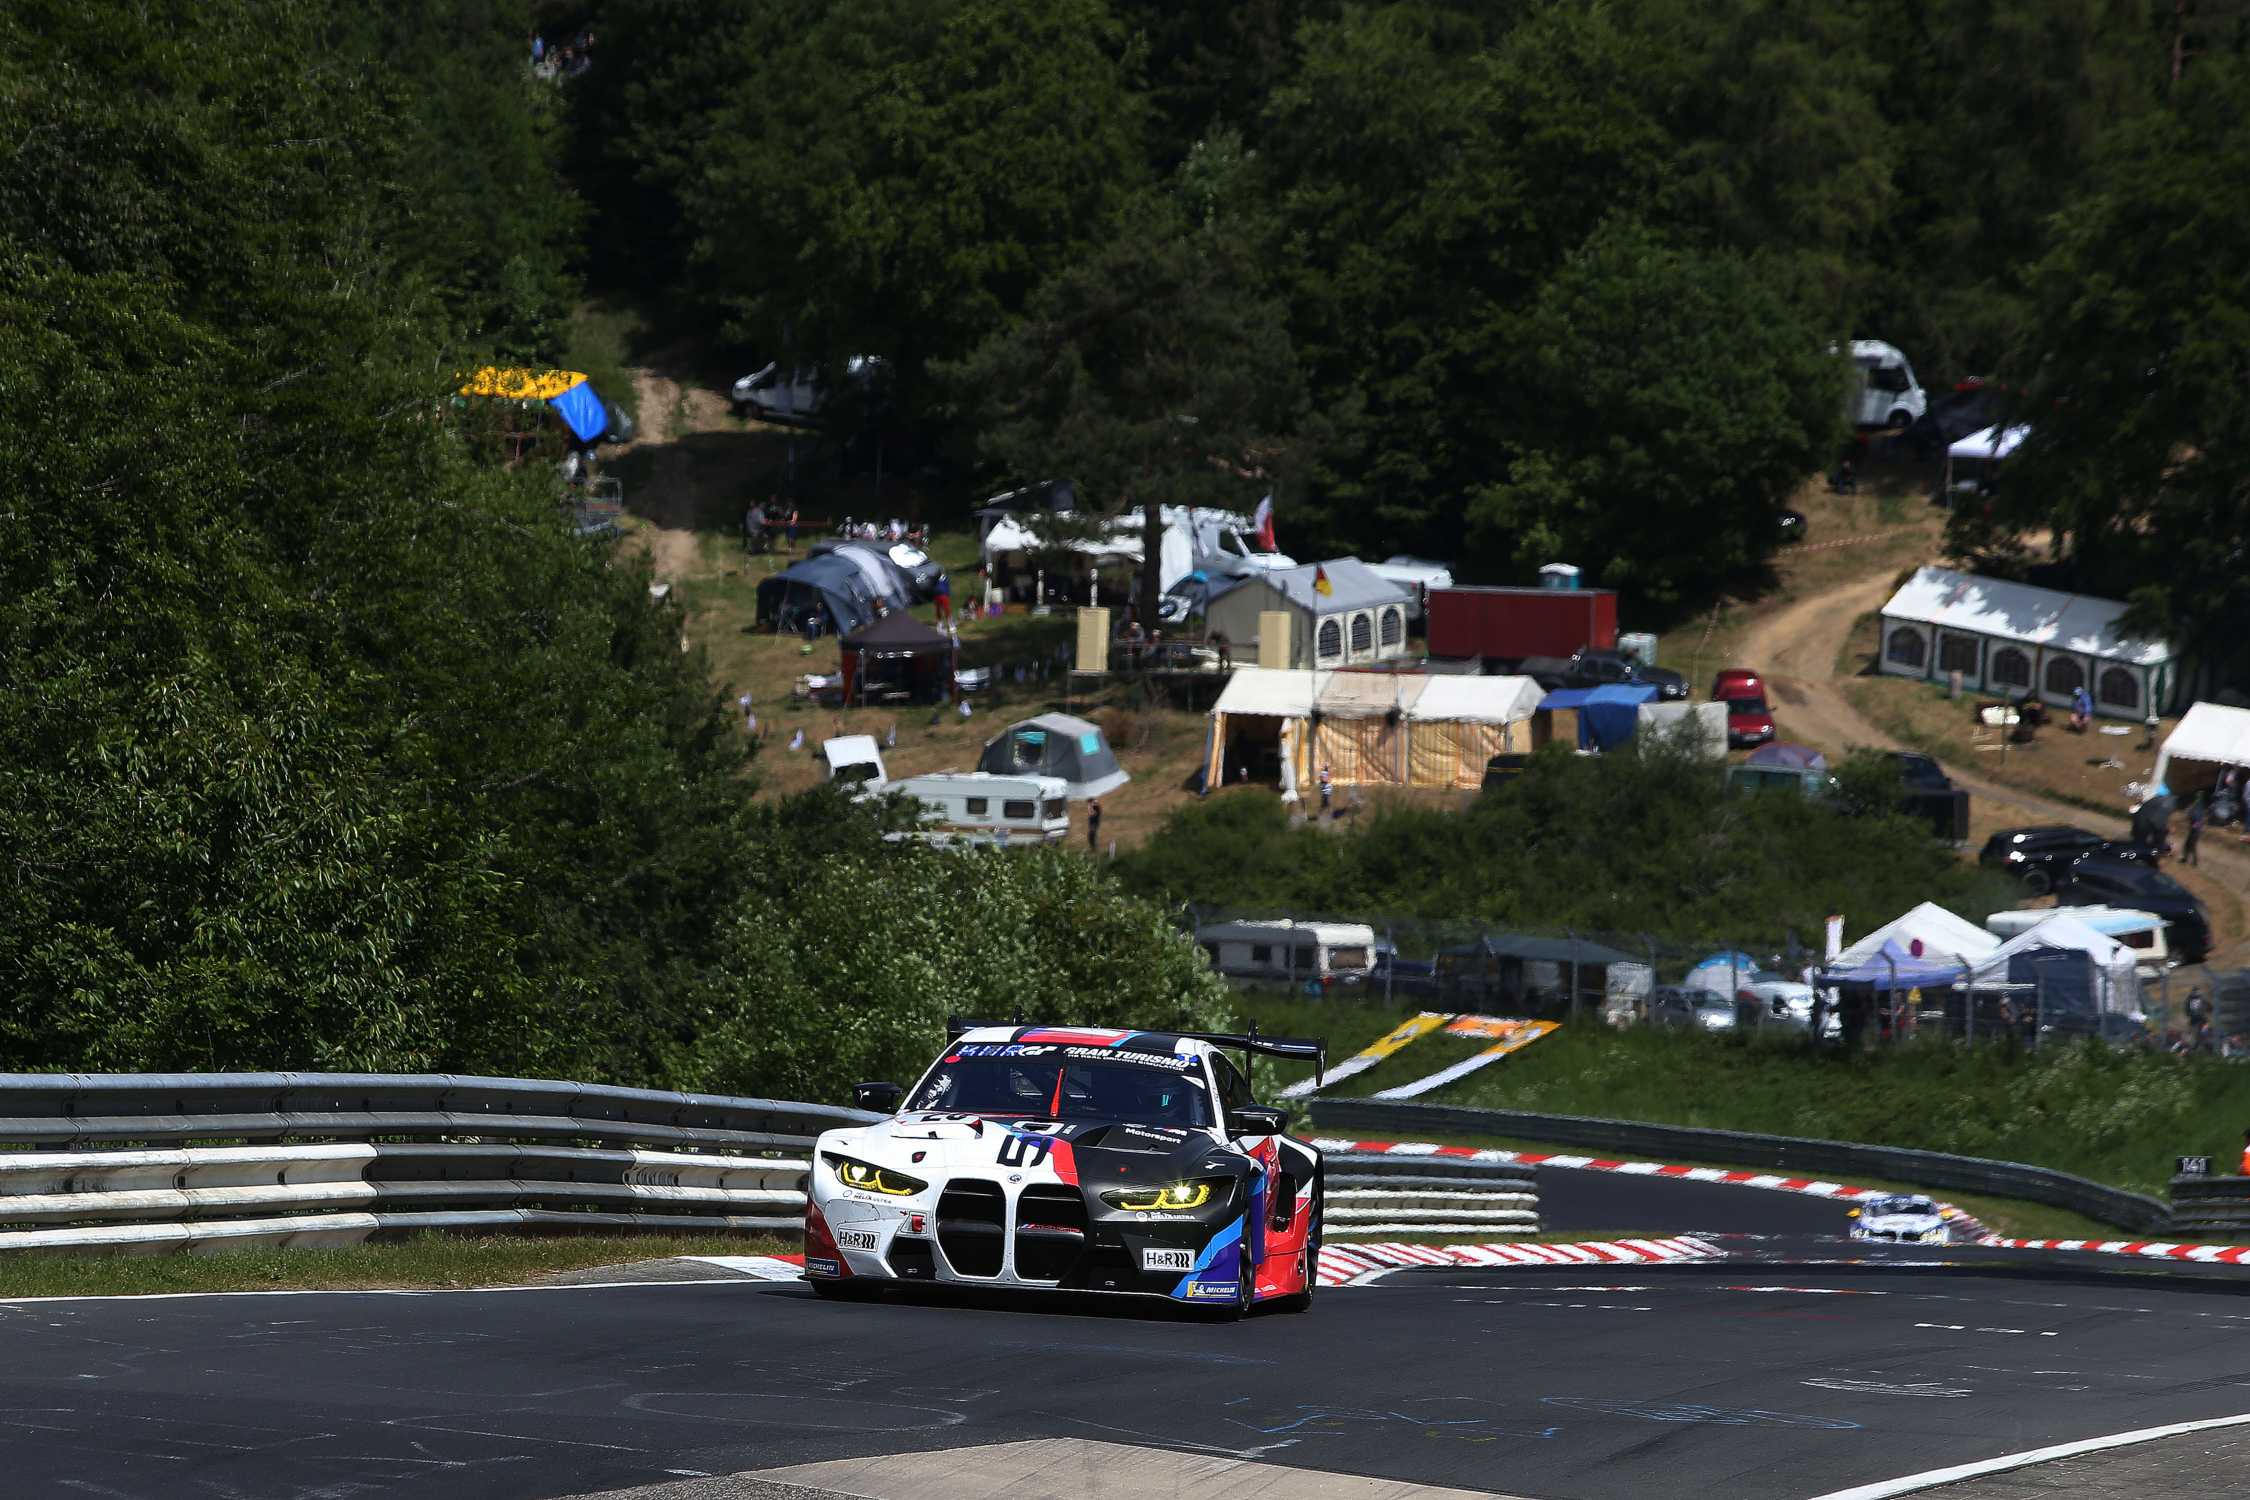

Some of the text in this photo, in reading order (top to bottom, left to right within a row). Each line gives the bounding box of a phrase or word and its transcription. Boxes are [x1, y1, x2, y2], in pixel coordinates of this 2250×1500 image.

[1063, 1046, 1190, 1068] GRAN TURISMO
[1125, 1128, 1182, 1144] Motorsport
[1206, 1286, 1236, 1294] MICHELIN
